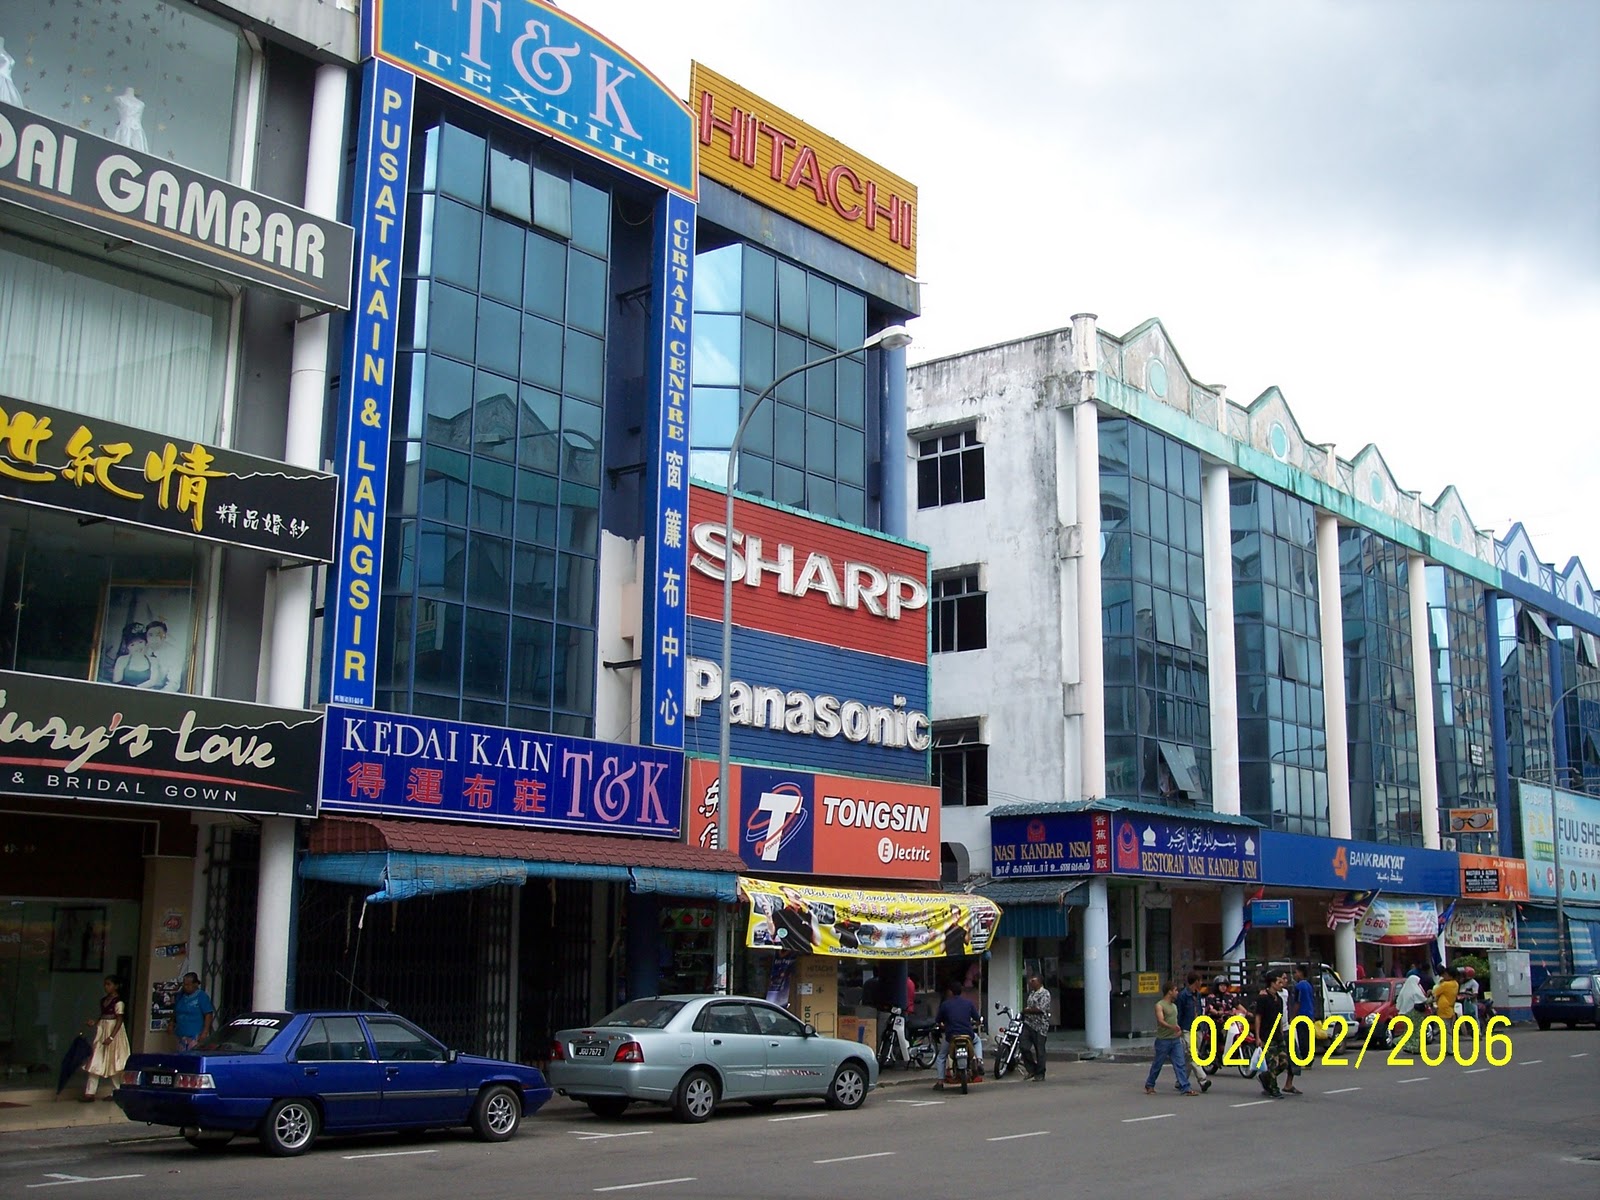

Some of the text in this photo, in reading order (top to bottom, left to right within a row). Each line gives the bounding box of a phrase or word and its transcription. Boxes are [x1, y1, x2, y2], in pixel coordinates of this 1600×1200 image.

[414, 41, 670, 175] TEXTILE
[452, 0, 643, 141] T&K
[374, 88, 402, 244] PUSAT
[700, 90, 913, 250] HITACHI
[96, 154, 326, 279] GAMBAR
[363, 255, 391, 386] KAIN
[667, 219, 689, 442] CURTAIN CENTRE
[361, 398, 382, 428] &
[343, 441, 376, 682] LANGSIR
[690, 521, 928, 620] SHARP
[175, 710, 275, 768] Love
[685, 655, 931, 751] Panasonic
[341, 717, 553, 774] KEDAI KAIN
[12, 771, 238, 802] & BRIDAL GOWN
[346, 761, 547, 813] 得運布莊
[562, 748, 670, 825] T&K
[823, 795, 931, 833] TONGSIN
[877, 837, 931, 864] Electric
[994, 841, 1092, 861] NASI KANDAR NSM
[1142, 851, 1258, 879] RESTORAN NASI KANDAR NSM
[1558, 817, 1579, 842] FUU
